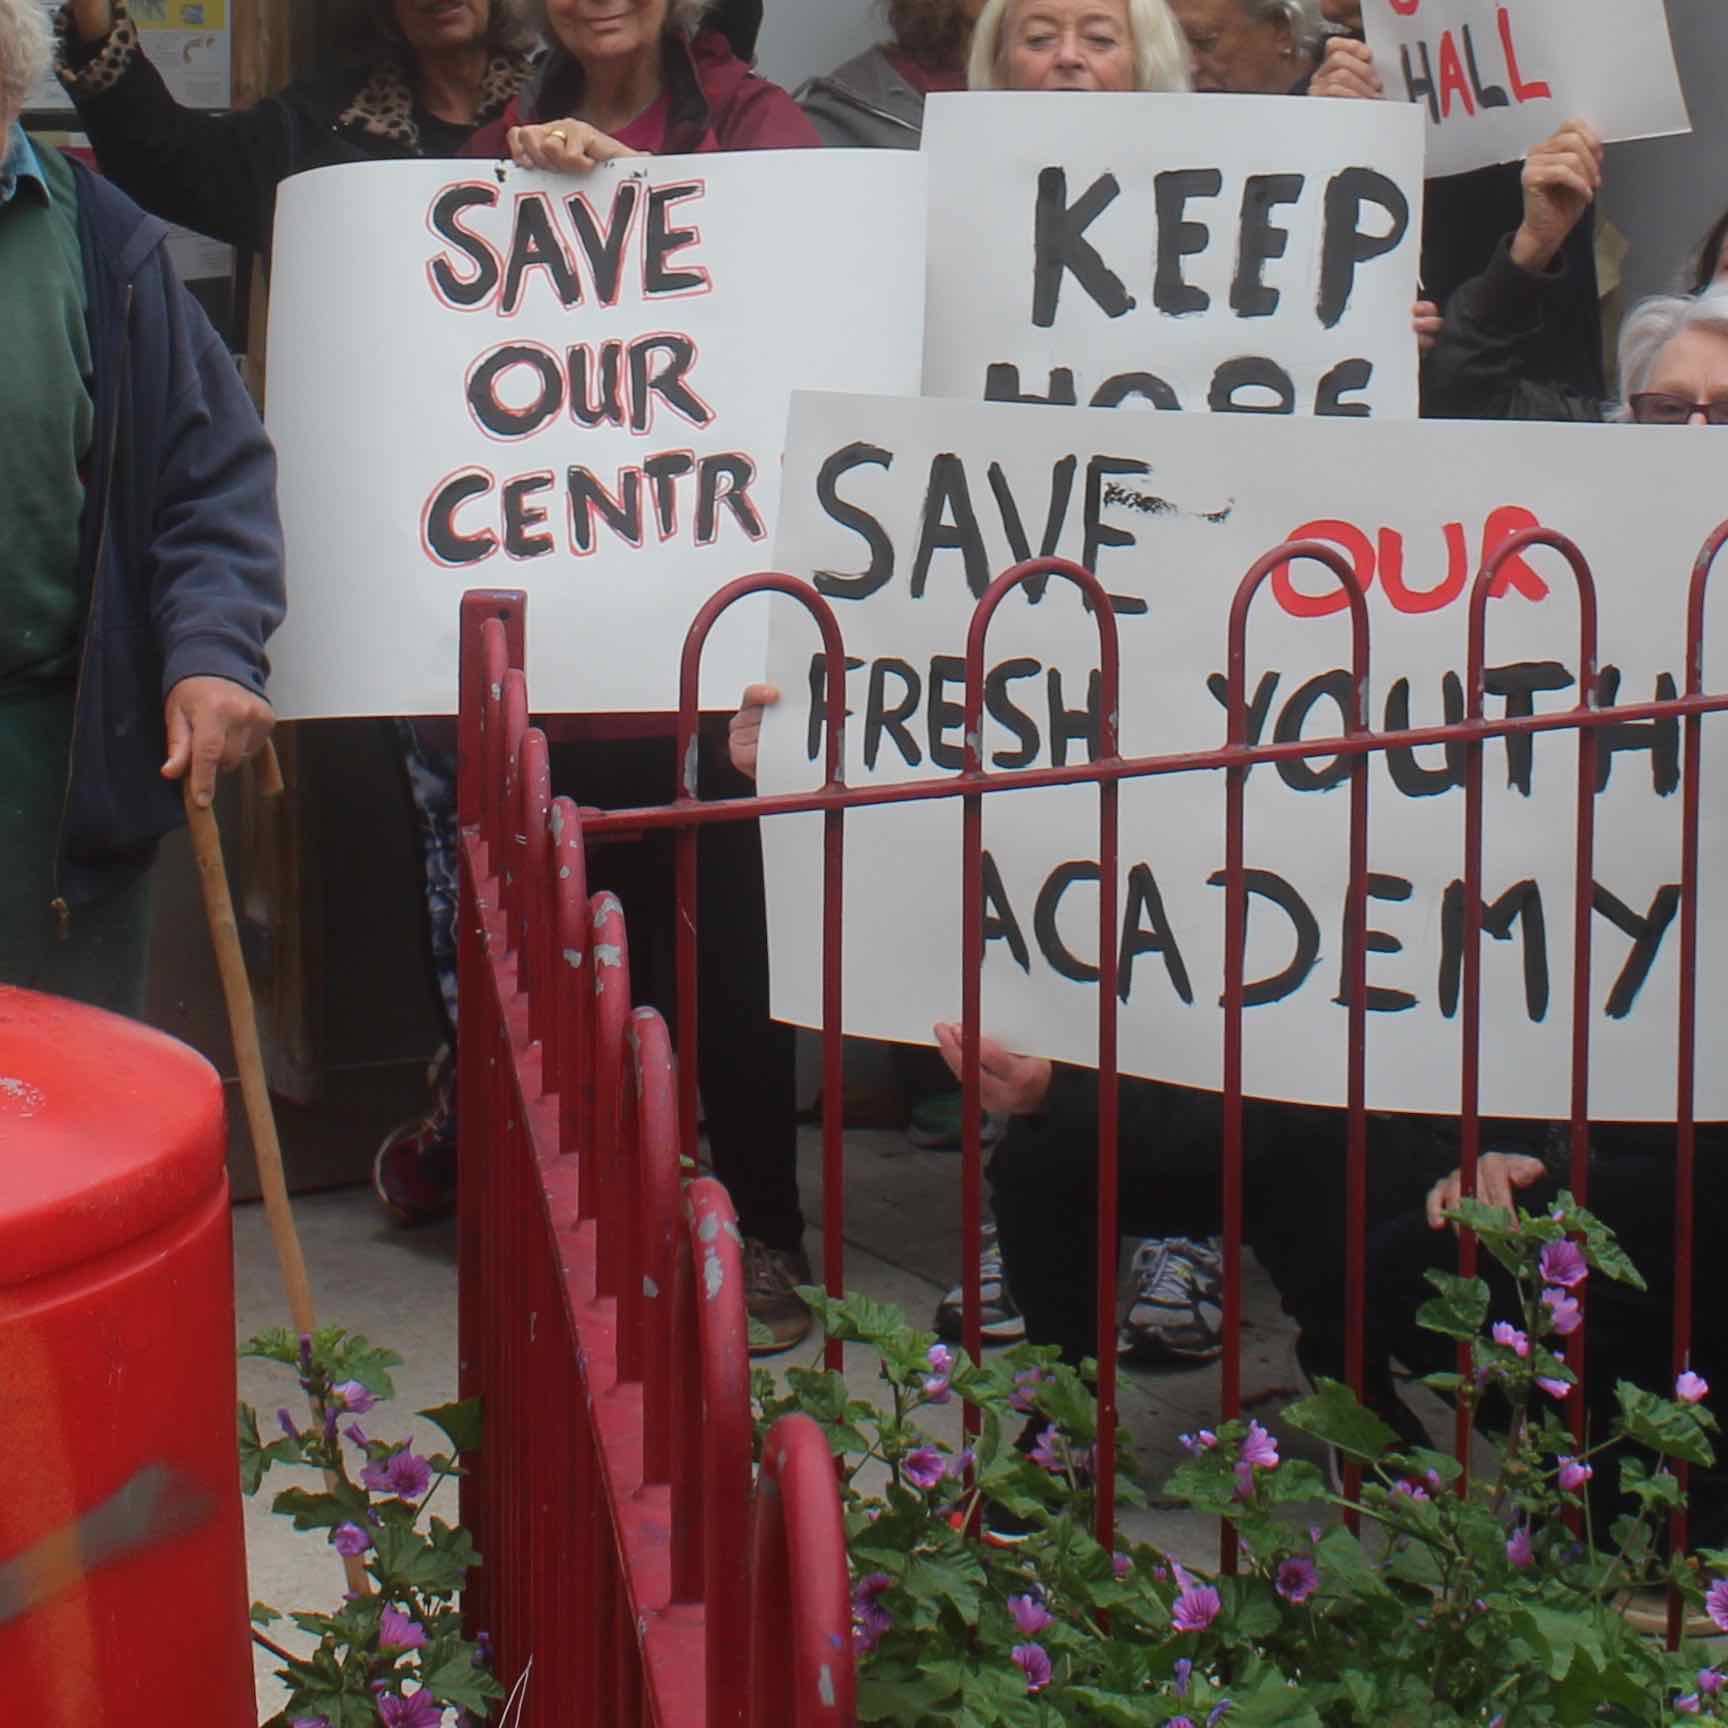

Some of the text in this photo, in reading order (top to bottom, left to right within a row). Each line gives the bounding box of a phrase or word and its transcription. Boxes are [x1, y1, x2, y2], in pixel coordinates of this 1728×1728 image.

[1400, 8, 1552, 124] HALL
[425, 179, 712, 316] SAVE
[1033, 166, 1409, 328] KEEP
[465, 332, 716, 441] OUR
[420, 450, 784, 568] CENTR
[813, 442, 1551, 617] SAVE OUR
[807, 653, 1681, 799] FRESH YOUTH
[977, 849, 1682, 1021] ACADEMY
